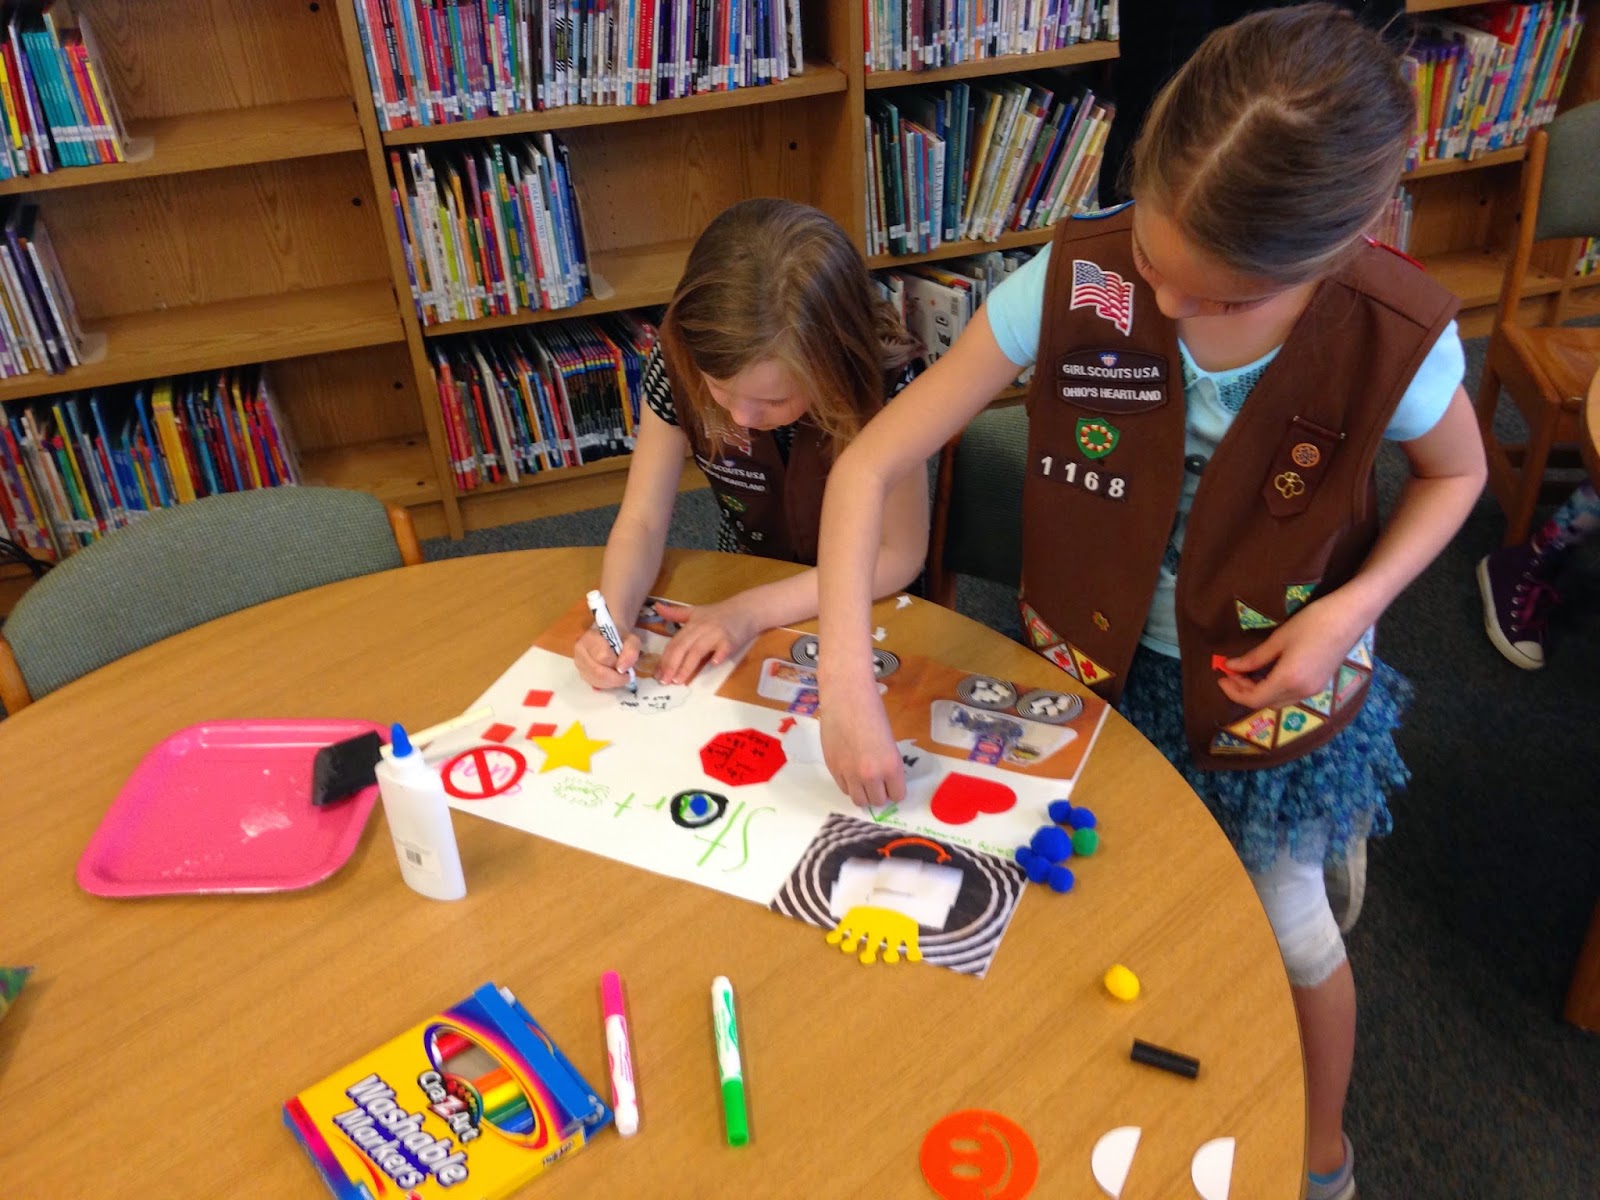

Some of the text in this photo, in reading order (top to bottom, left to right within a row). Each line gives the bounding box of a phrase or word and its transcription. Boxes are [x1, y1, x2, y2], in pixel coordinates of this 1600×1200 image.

[1062, 363, 1160, 379] GIRL SCOUTS USA
[1062, 387, 1162, 401] OHIO'S HEARTLAND
[745, 471, 766, 481] USA
[345, 1072, 470, 1188] Washable
[332, 1106, 427, 1190] Markers
